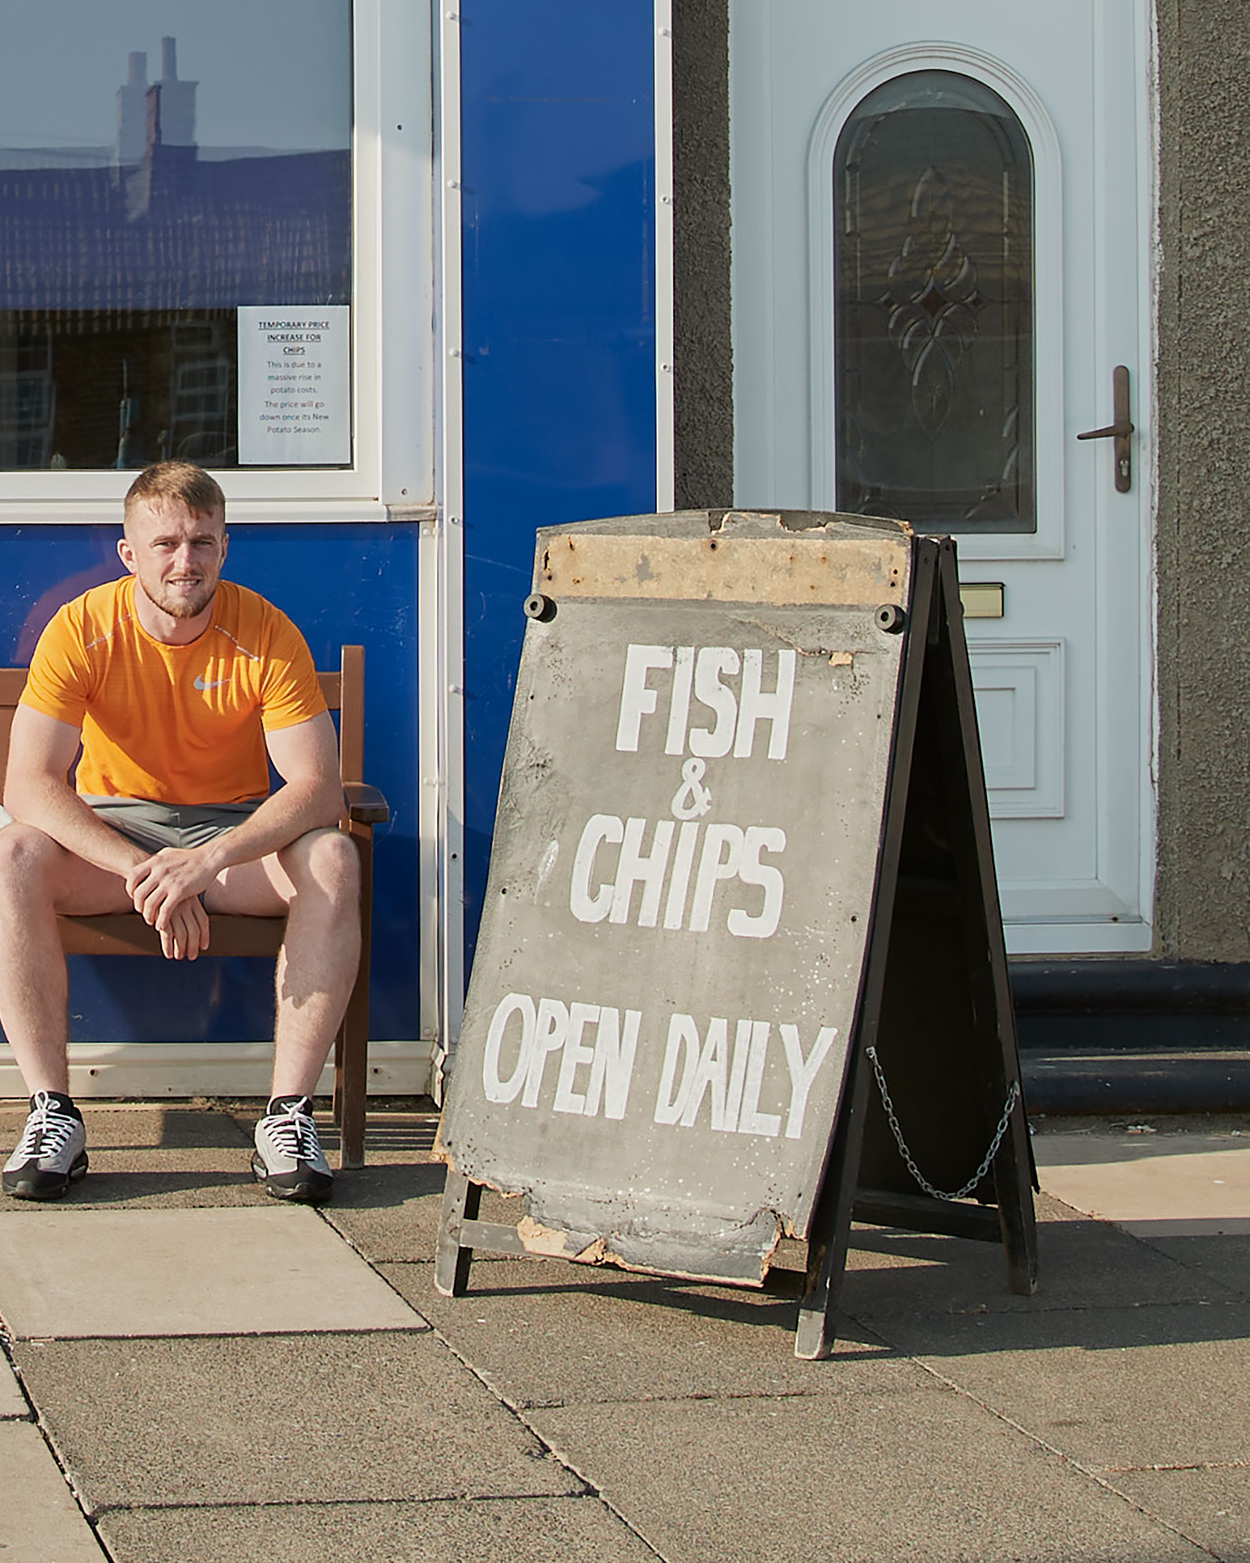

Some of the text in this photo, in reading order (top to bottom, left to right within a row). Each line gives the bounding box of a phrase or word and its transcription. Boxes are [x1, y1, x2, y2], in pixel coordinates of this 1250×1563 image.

[258, 321, 330, 329] TEMPORARY PRICE
[283, 346, 306, 354] CHIPS
[259, 413, 280, 421] down
[280, 401, 298, 409] price
[615, 643, 797, 761] FISH
[670, 758, 712, 821] &
[569, 813, 787, 938] CHIPS
[482, 993, 838, 1140] OPEN DAILY
